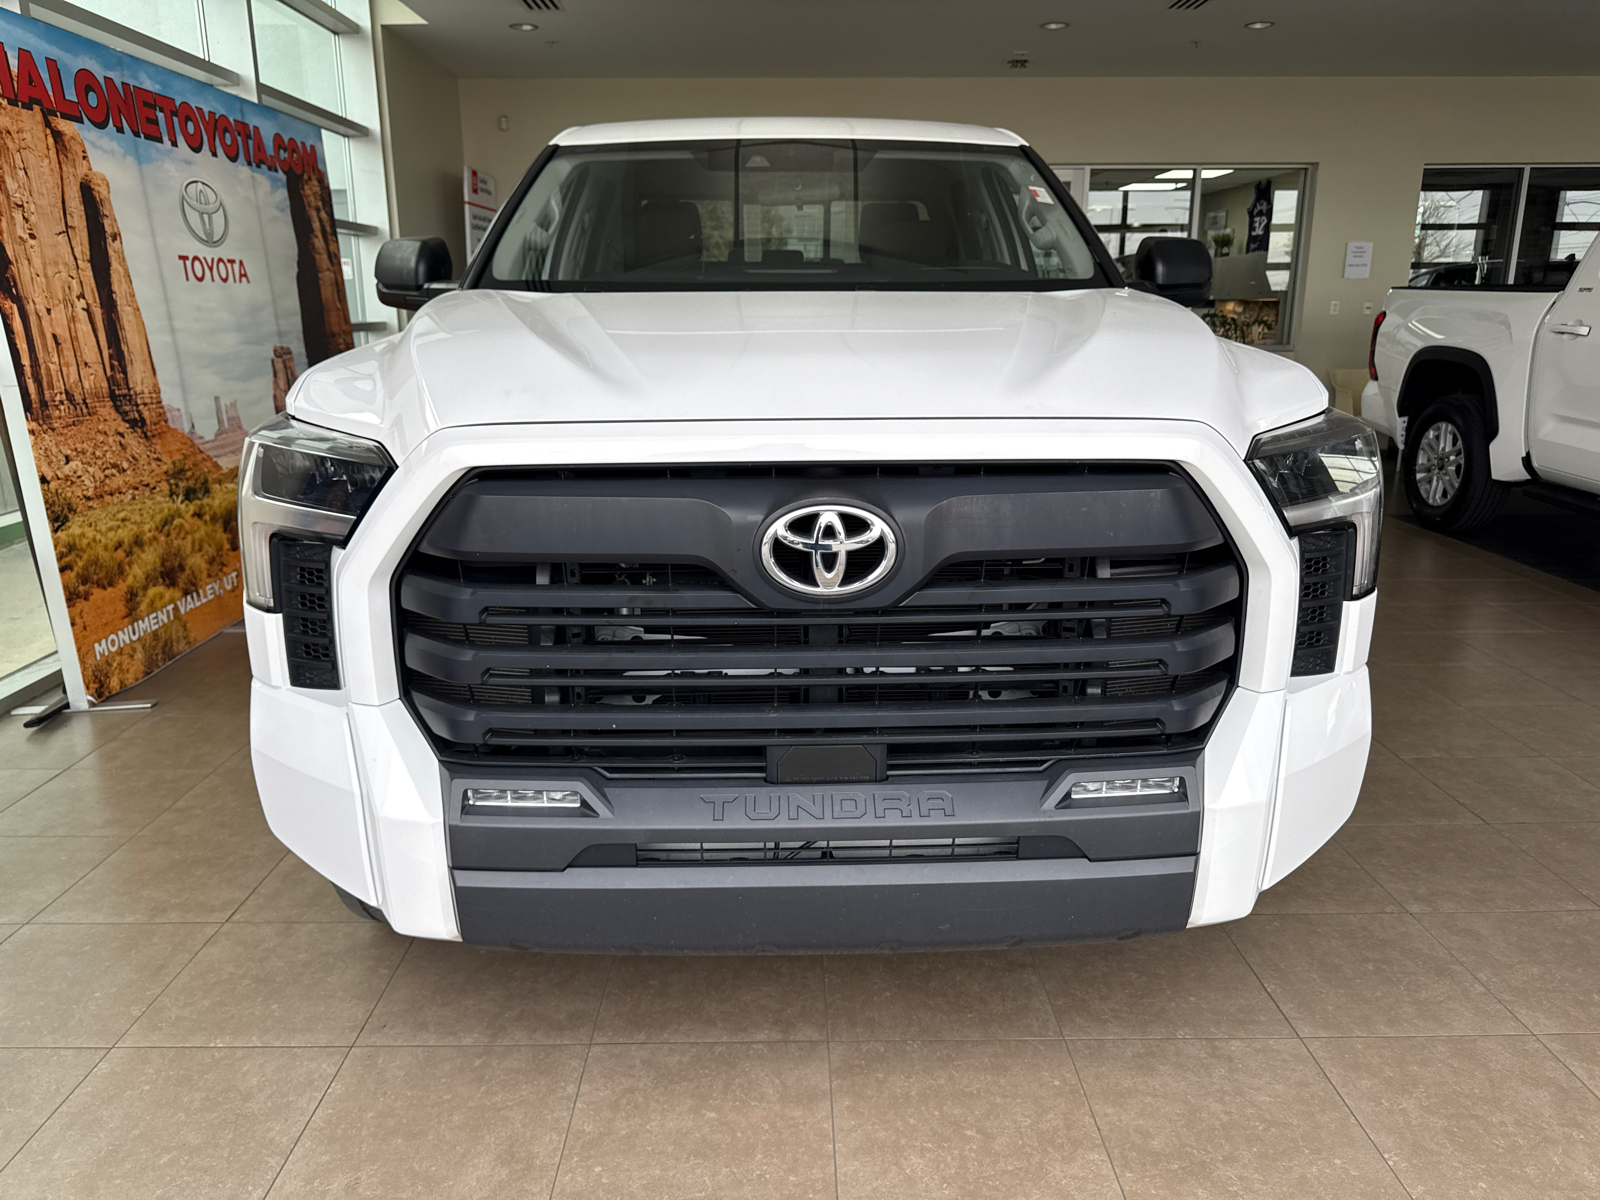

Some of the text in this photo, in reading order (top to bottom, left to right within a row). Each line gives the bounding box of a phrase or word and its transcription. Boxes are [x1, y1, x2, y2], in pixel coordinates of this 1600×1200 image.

[1251, 216, 1267, 236] 32
[178, 255, 250, 284] TOYOTA
[93, 571, 239, 661] MONUMENT VALLEY, UT
[700, 790, 956, 821] TUNDRA
